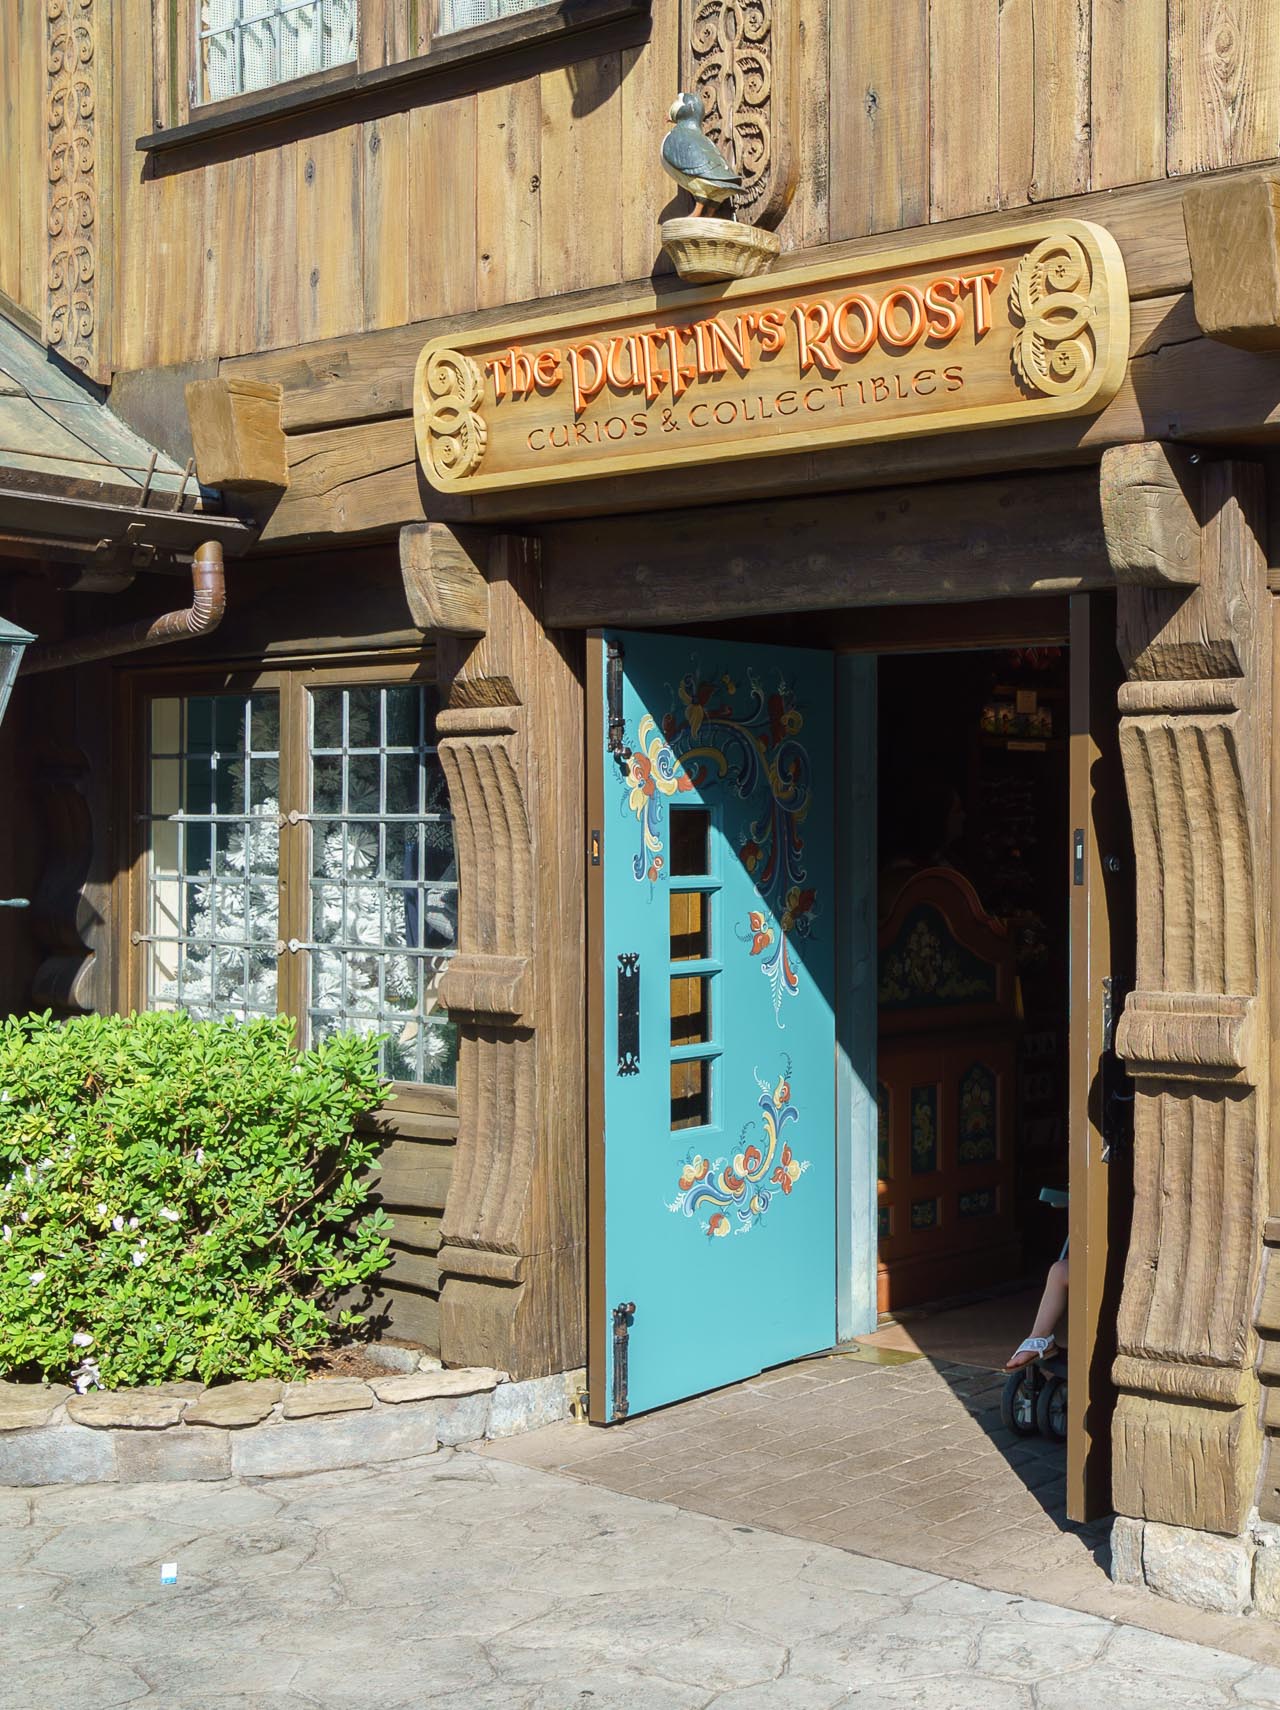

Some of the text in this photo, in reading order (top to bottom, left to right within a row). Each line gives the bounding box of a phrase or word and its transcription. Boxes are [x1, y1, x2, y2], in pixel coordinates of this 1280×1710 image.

[484, 346, 563, 399] The
[790, 267, 1004, 371] ROOST
[527, 366, 963, 451] CURIOS & COLLECTIBLES
